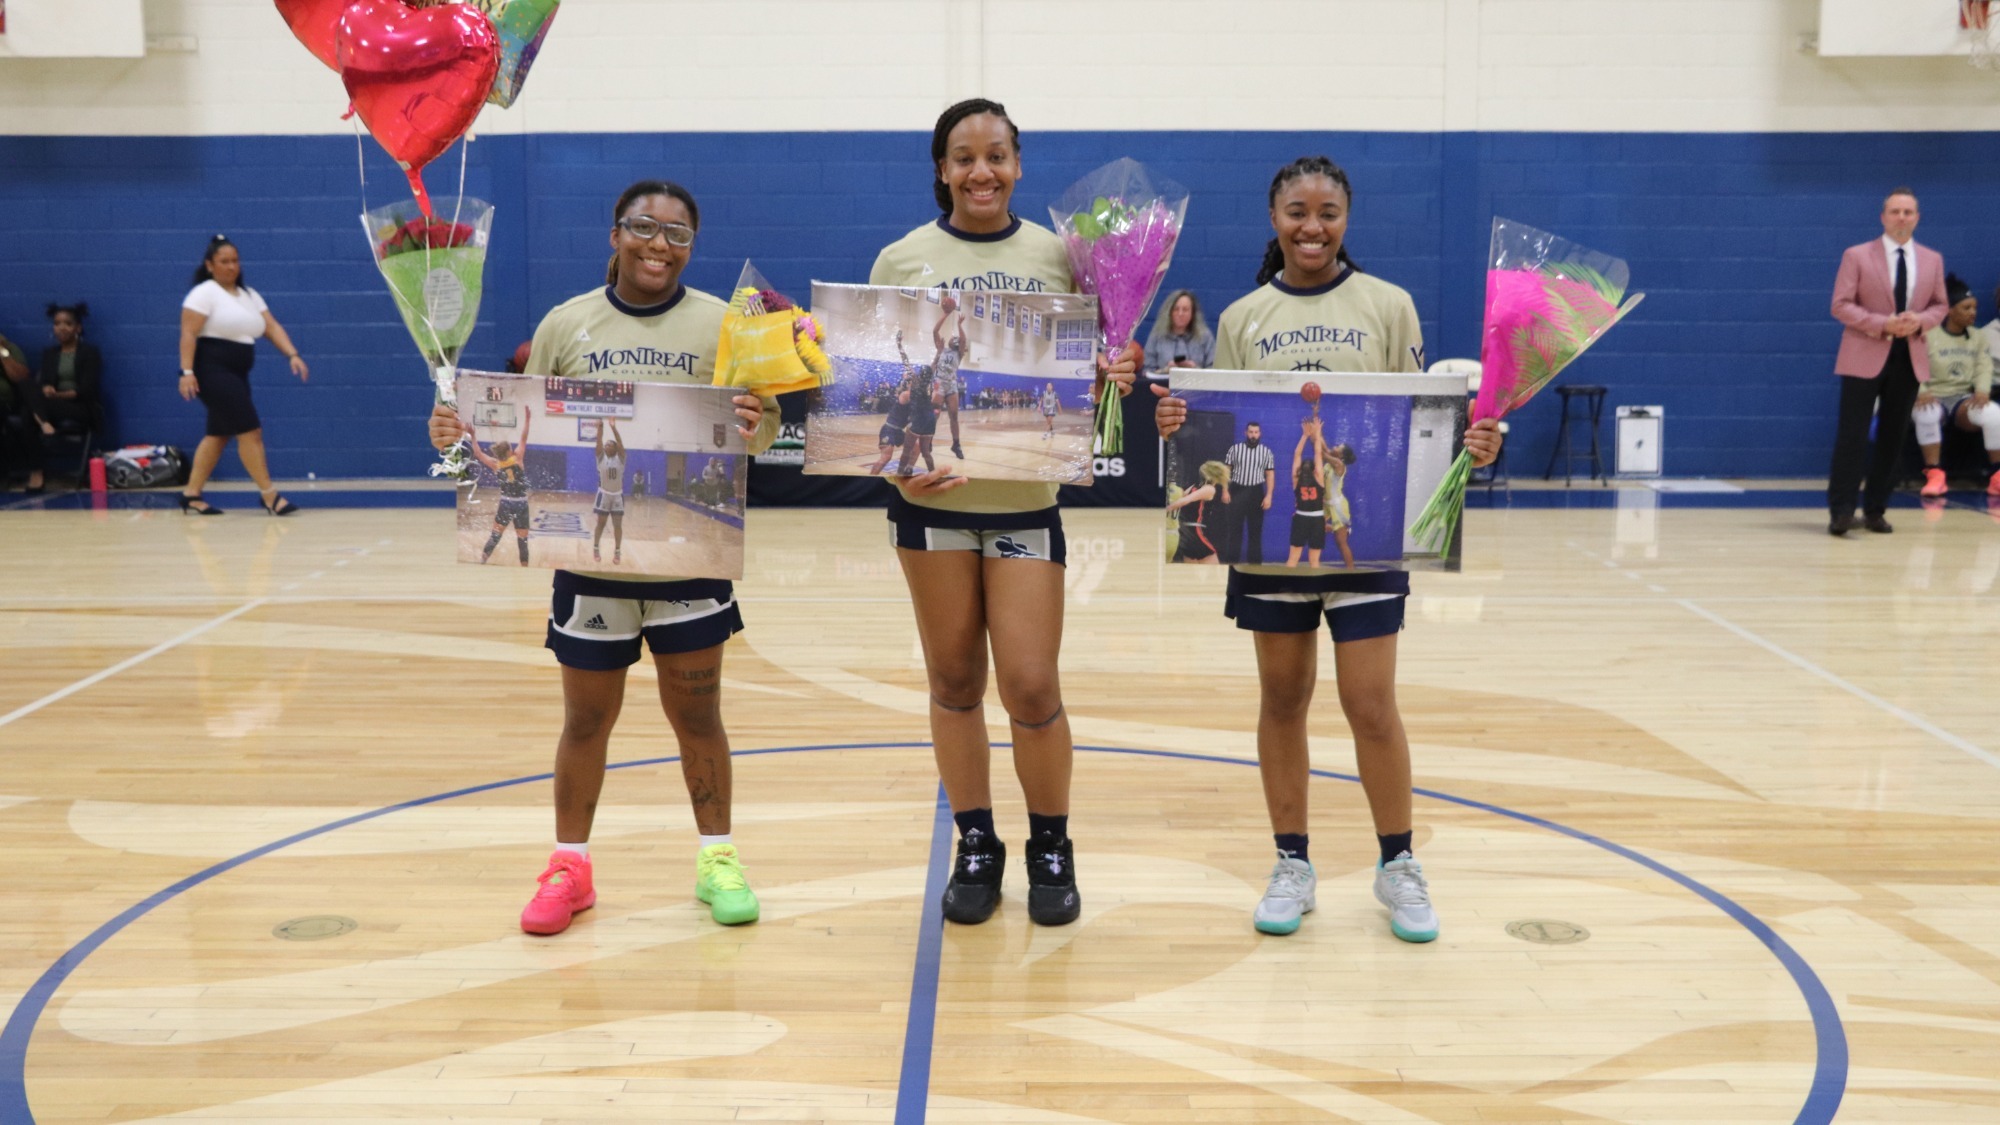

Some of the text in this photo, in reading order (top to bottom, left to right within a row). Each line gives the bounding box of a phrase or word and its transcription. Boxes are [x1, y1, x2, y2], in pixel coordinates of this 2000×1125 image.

[1255, 325, 1368, 359] MONTREAT
[1281, 346, 1340, 355] COLLEGE
[582, 347, 699, 375] MONTREAT
[777, 423, 805, 440] AC
[1300, 486, 1318, 500] 53
[584, 622, 608, 630] adidas
